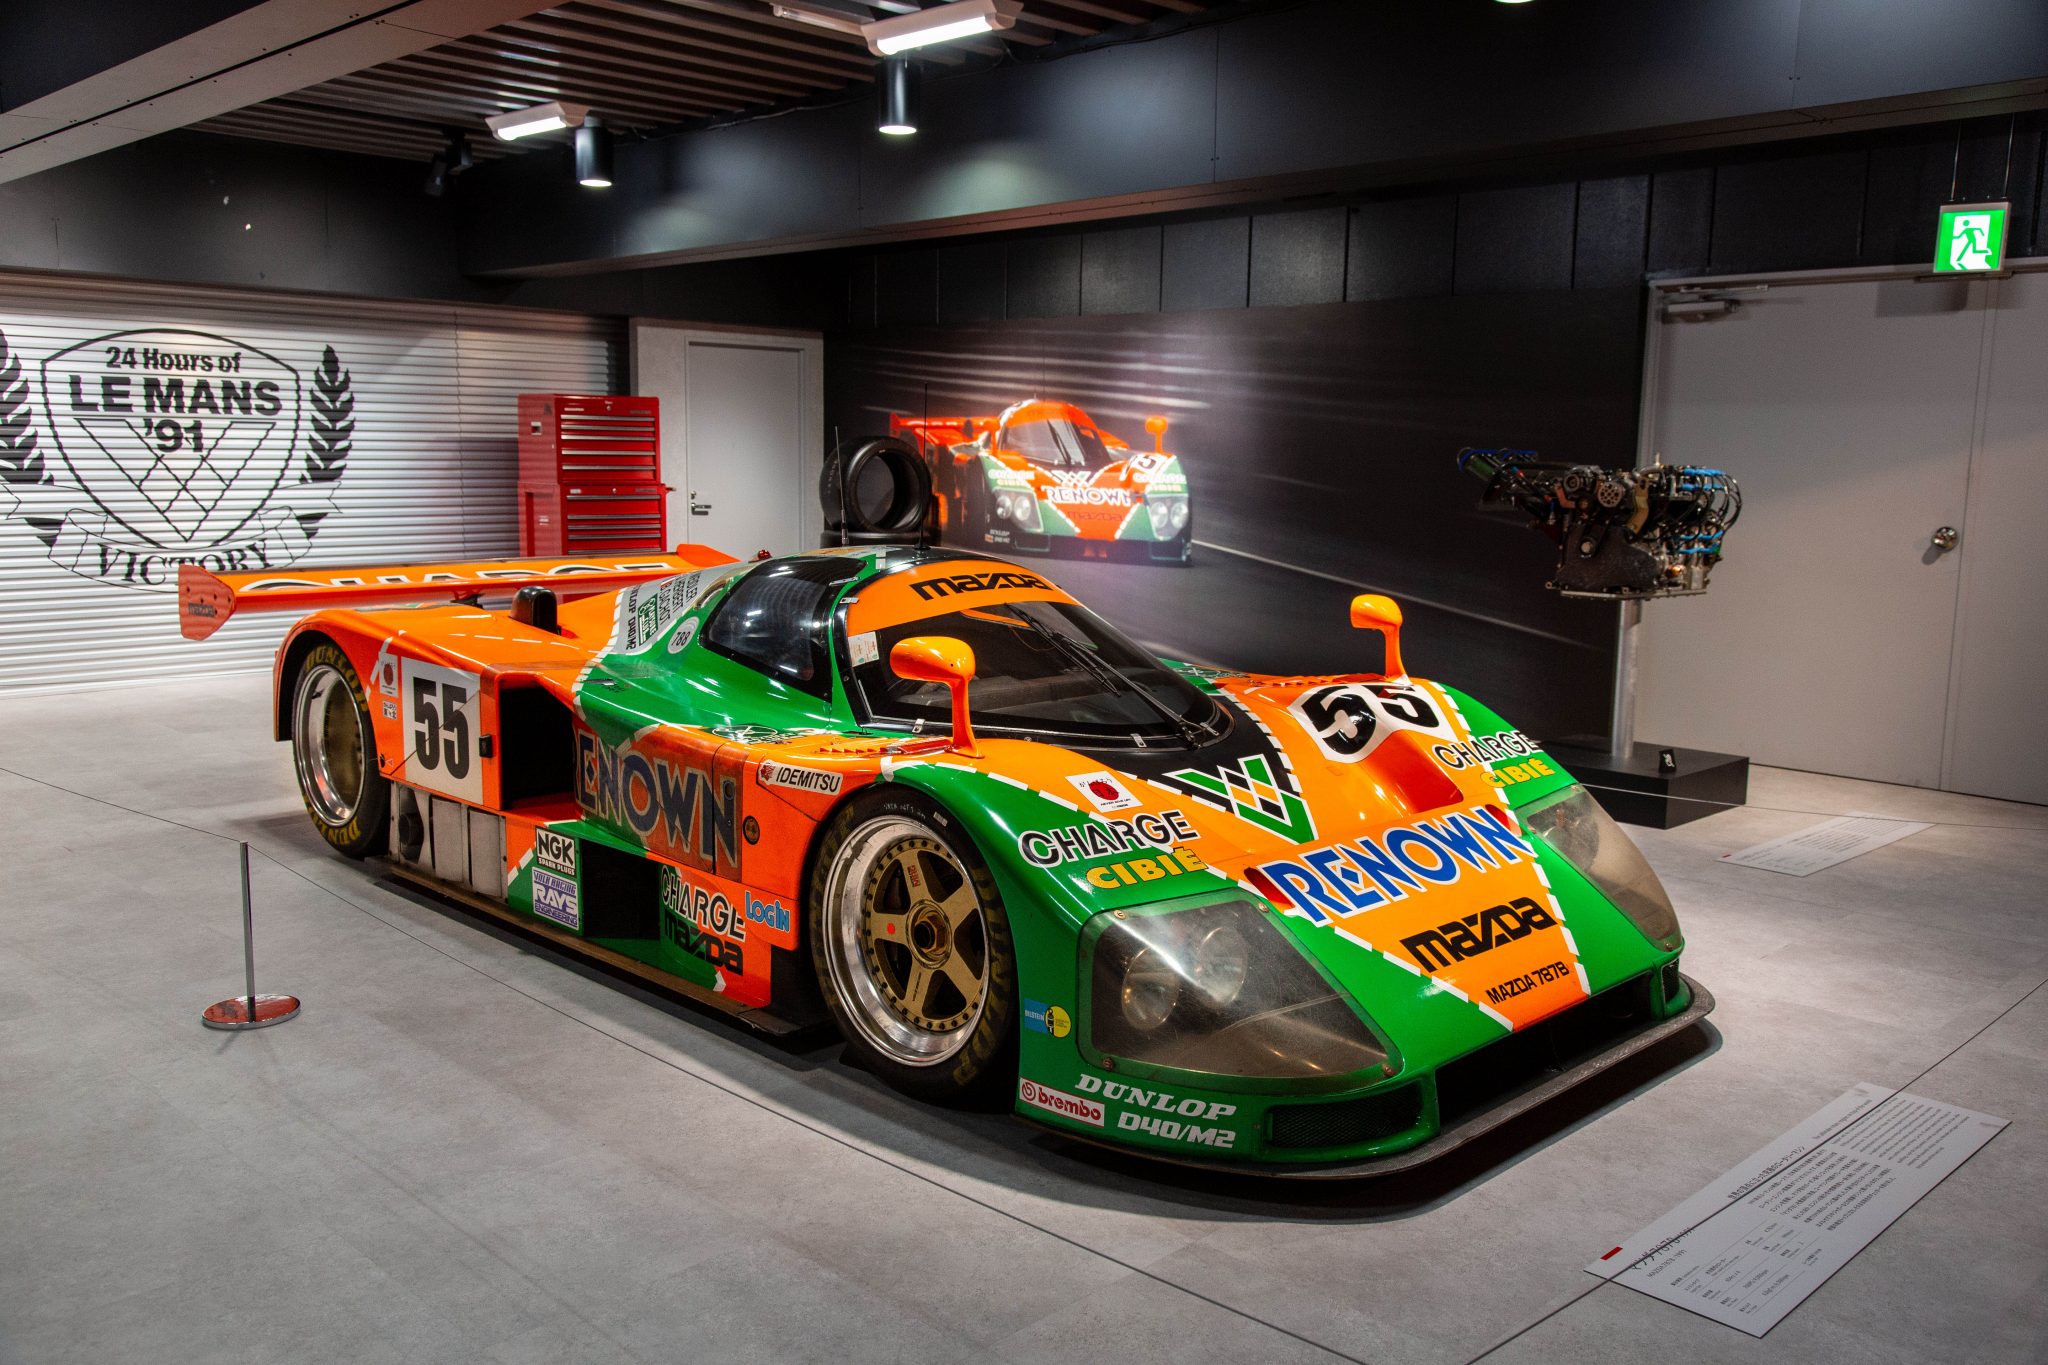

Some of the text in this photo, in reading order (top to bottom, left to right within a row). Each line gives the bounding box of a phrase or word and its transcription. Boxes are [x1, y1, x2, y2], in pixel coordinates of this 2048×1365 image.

[105, 346, 243, 373] 24 Hours of
[68, 374, 283, 417] LE MANS
[1042, 486, 1133, 507] RENOWN
[412, 678, 470, 780] 55
[1301, 685, 1440, 755] 55
[1432, 730, 1542, 771] CHARGE
[577, 729, 738, 868] ENOWN
[776, 766, 840, 793] IDEMITSU
[537, 831, 574, 867] NGK
[1018, 809, 1201, 869] CHARGE
[556, 863, 575, 876] PLUGS
[1257, 805, 1538, 928] RENOWN
[535, 883, 578, 916] RAYS
[661, 865, 747, 943] CHARGE
[1485, 960, 1570, 1005] MAZDA 787B
[1038, 1085, 1102, 1121] brembo
[1075, 1073, 1237, 1121] DUNLOP
[1117, 1111, 1236, 1149] D40/M2
